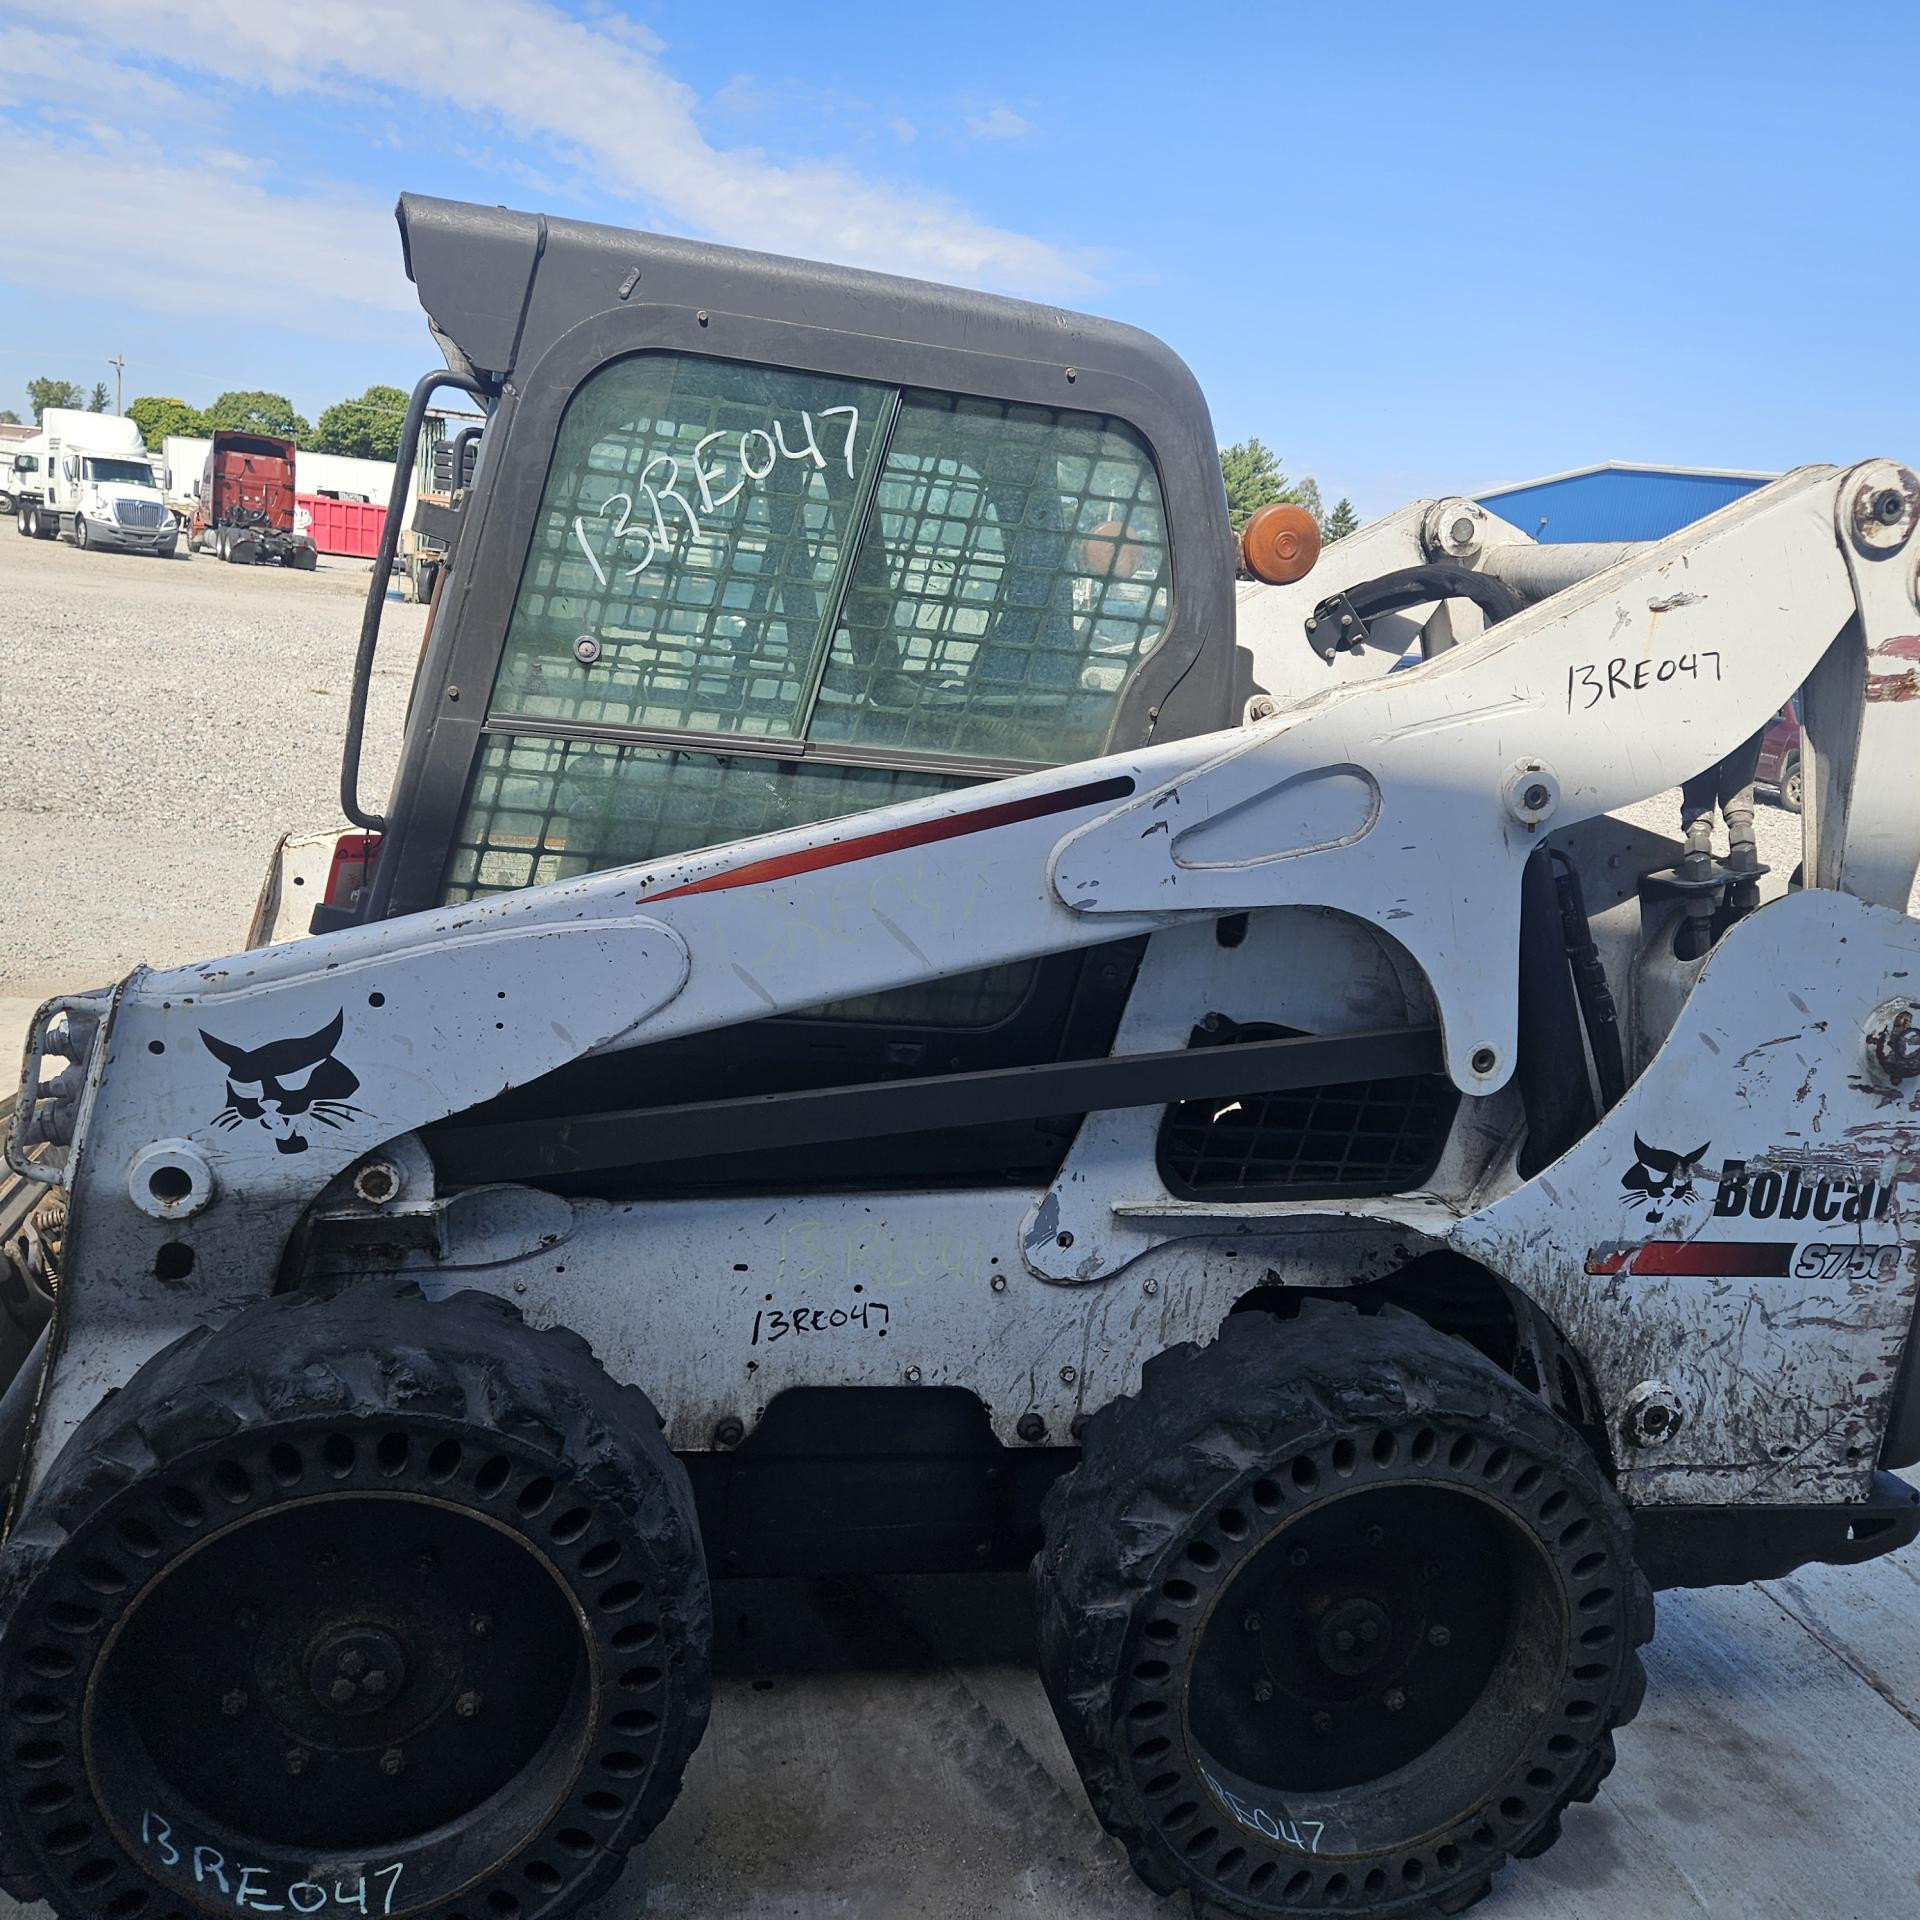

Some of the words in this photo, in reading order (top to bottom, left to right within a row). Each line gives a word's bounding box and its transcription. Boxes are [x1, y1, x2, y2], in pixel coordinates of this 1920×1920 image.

[574, 405, 859, 586] 13RE047
[1567, 651, 1722, 716] 13RE047
[1795, 1243, 1902, 1280] S750
[750, 1301, 889, 1346] 13RE047
[142, 1808, 403, 1915] 13RE047
